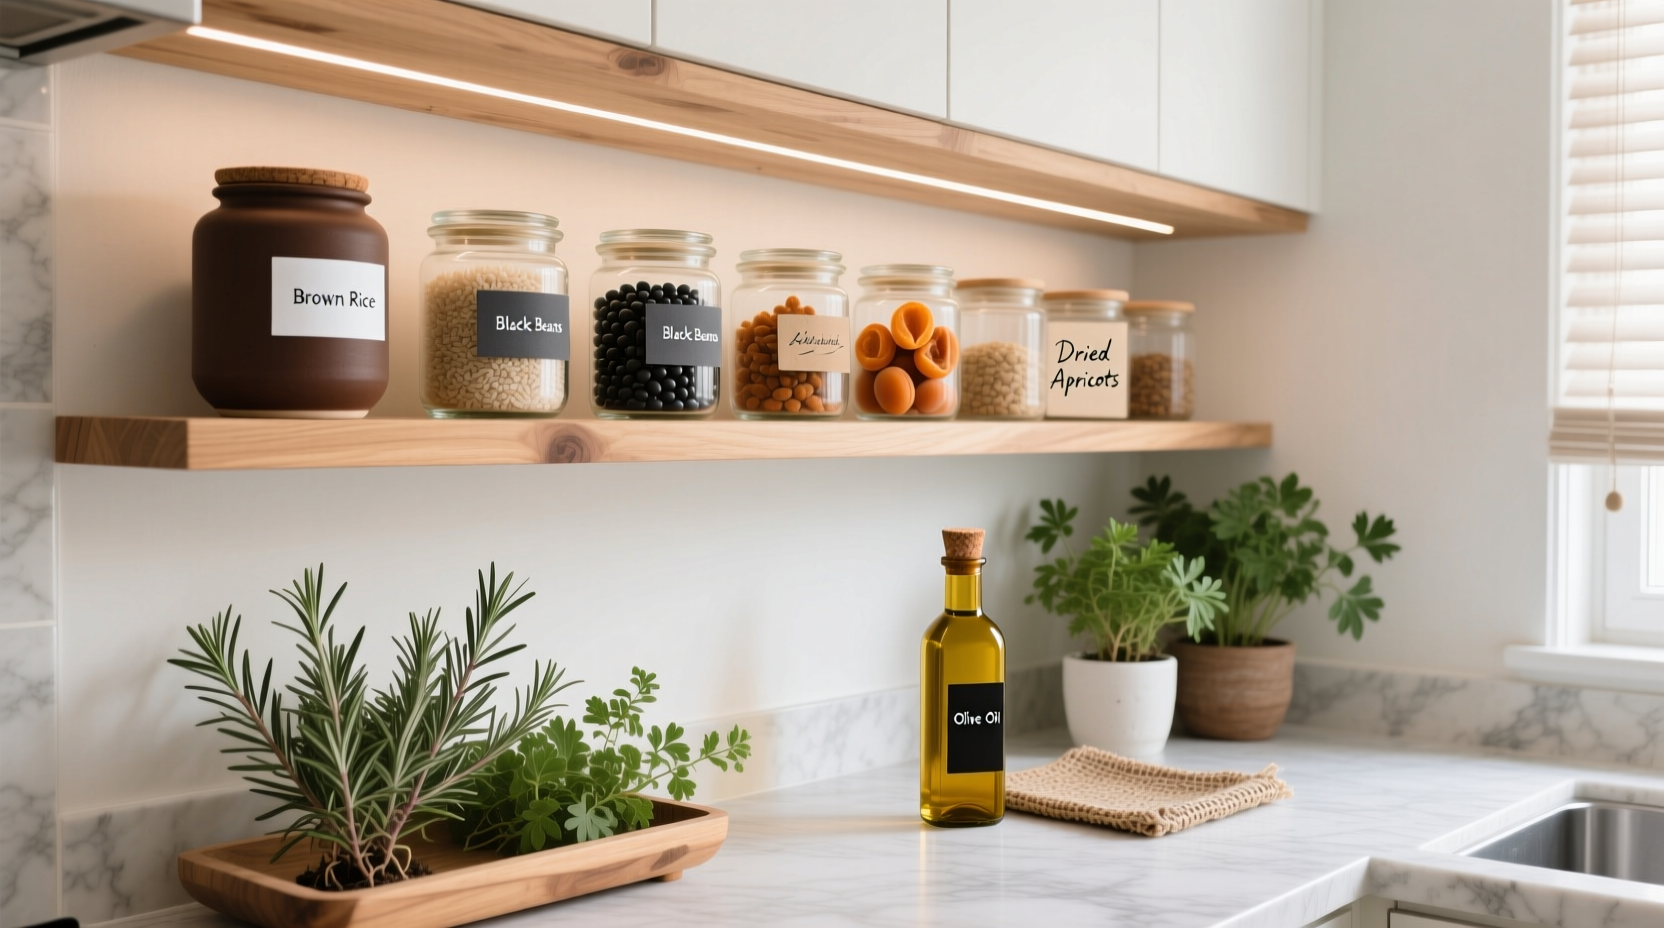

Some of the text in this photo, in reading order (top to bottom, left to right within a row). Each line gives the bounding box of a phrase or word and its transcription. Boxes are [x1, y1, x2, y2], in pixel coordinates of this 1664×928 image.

[293, 288, 376, 308] Brown Rice
[496, 315, 533, 332] Black
[662, 325, 693, 341] Black
[1055, 337, 1112, 364] Dried
[1050, 367, 1120, 397] Apricots
[953, 710, 1001, 725] Olive Oil
